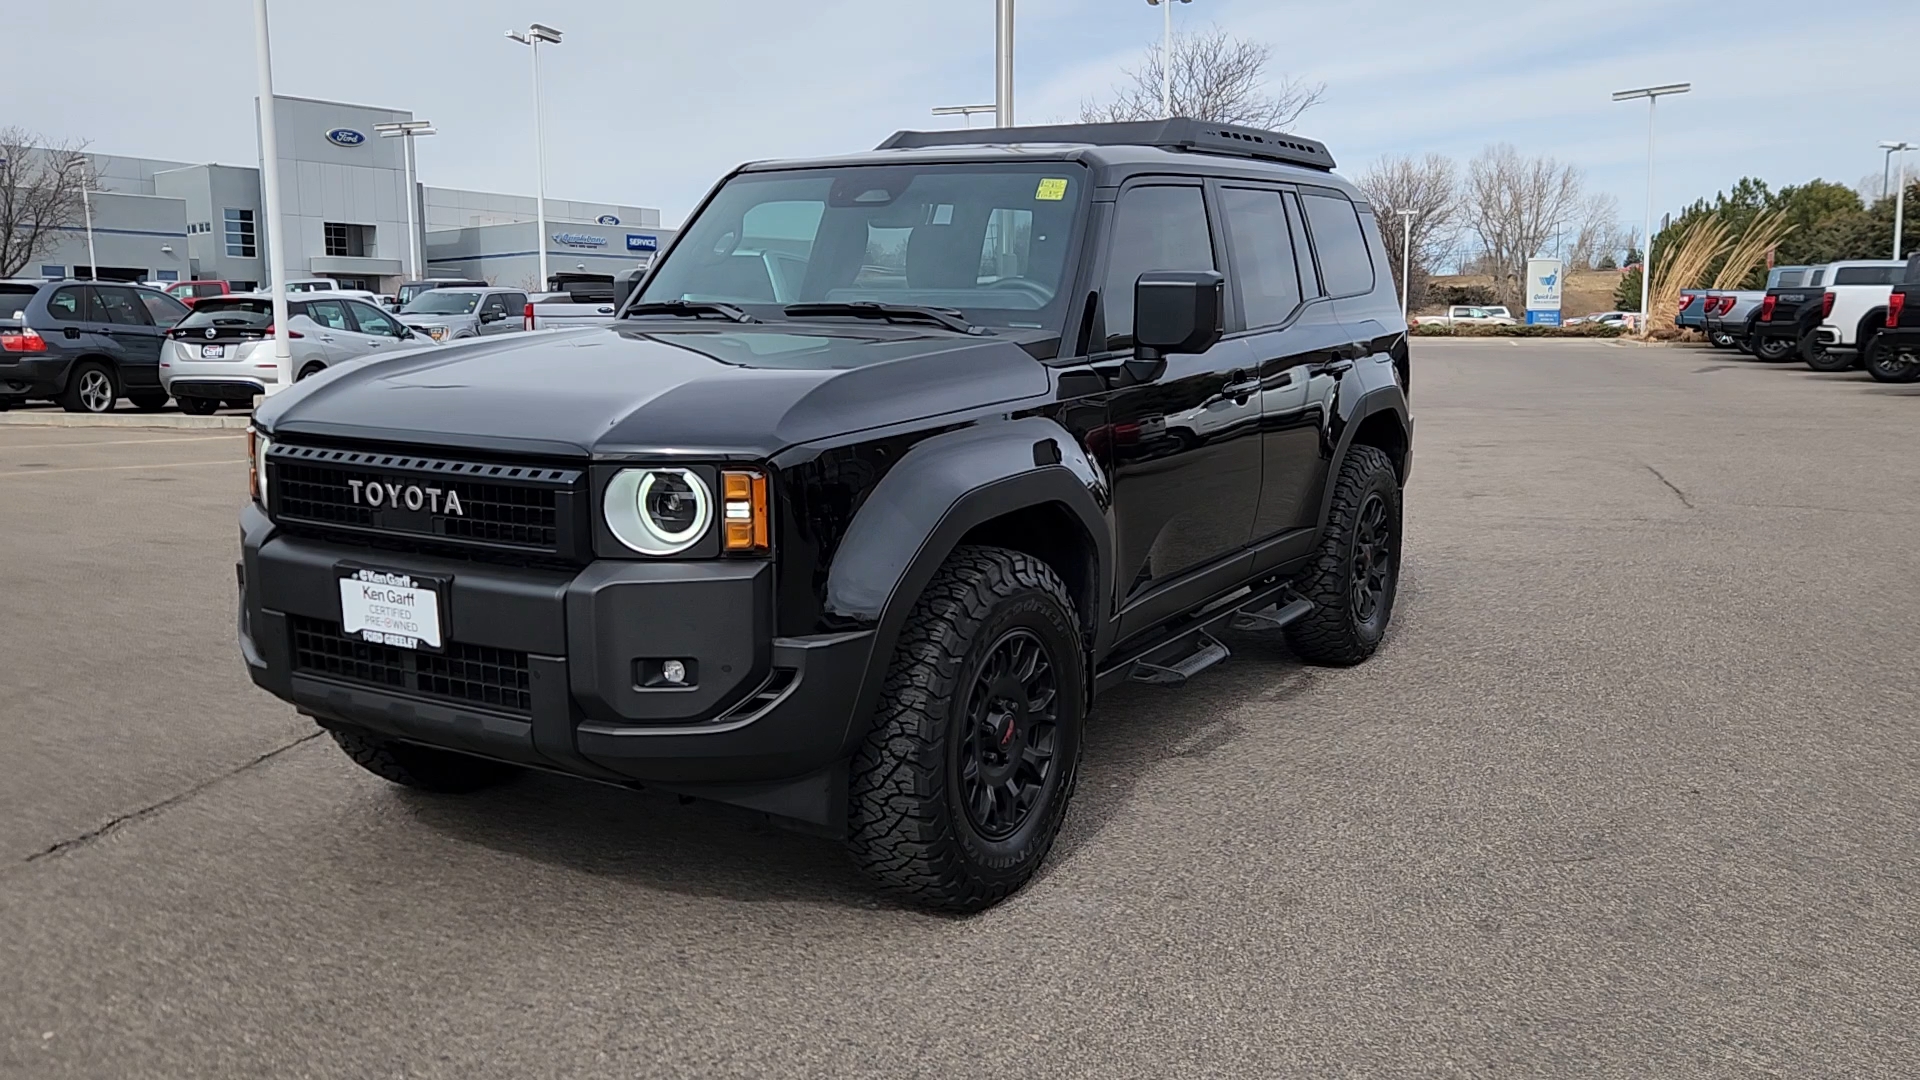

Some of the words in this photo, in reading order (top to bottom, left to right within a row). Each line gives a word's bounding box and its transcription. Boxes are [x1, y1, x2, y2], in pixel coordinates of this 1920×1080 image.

[336, 131, 359, 143] Ford
[629, 238, 656, 247] SERVICE
[347, 479, 464, 516] TOYOTA
[361, 585, 385, 602] Ken
[386, 589, 415, 607] Garff
[368, 604, 412, 620] CERTIFIED
